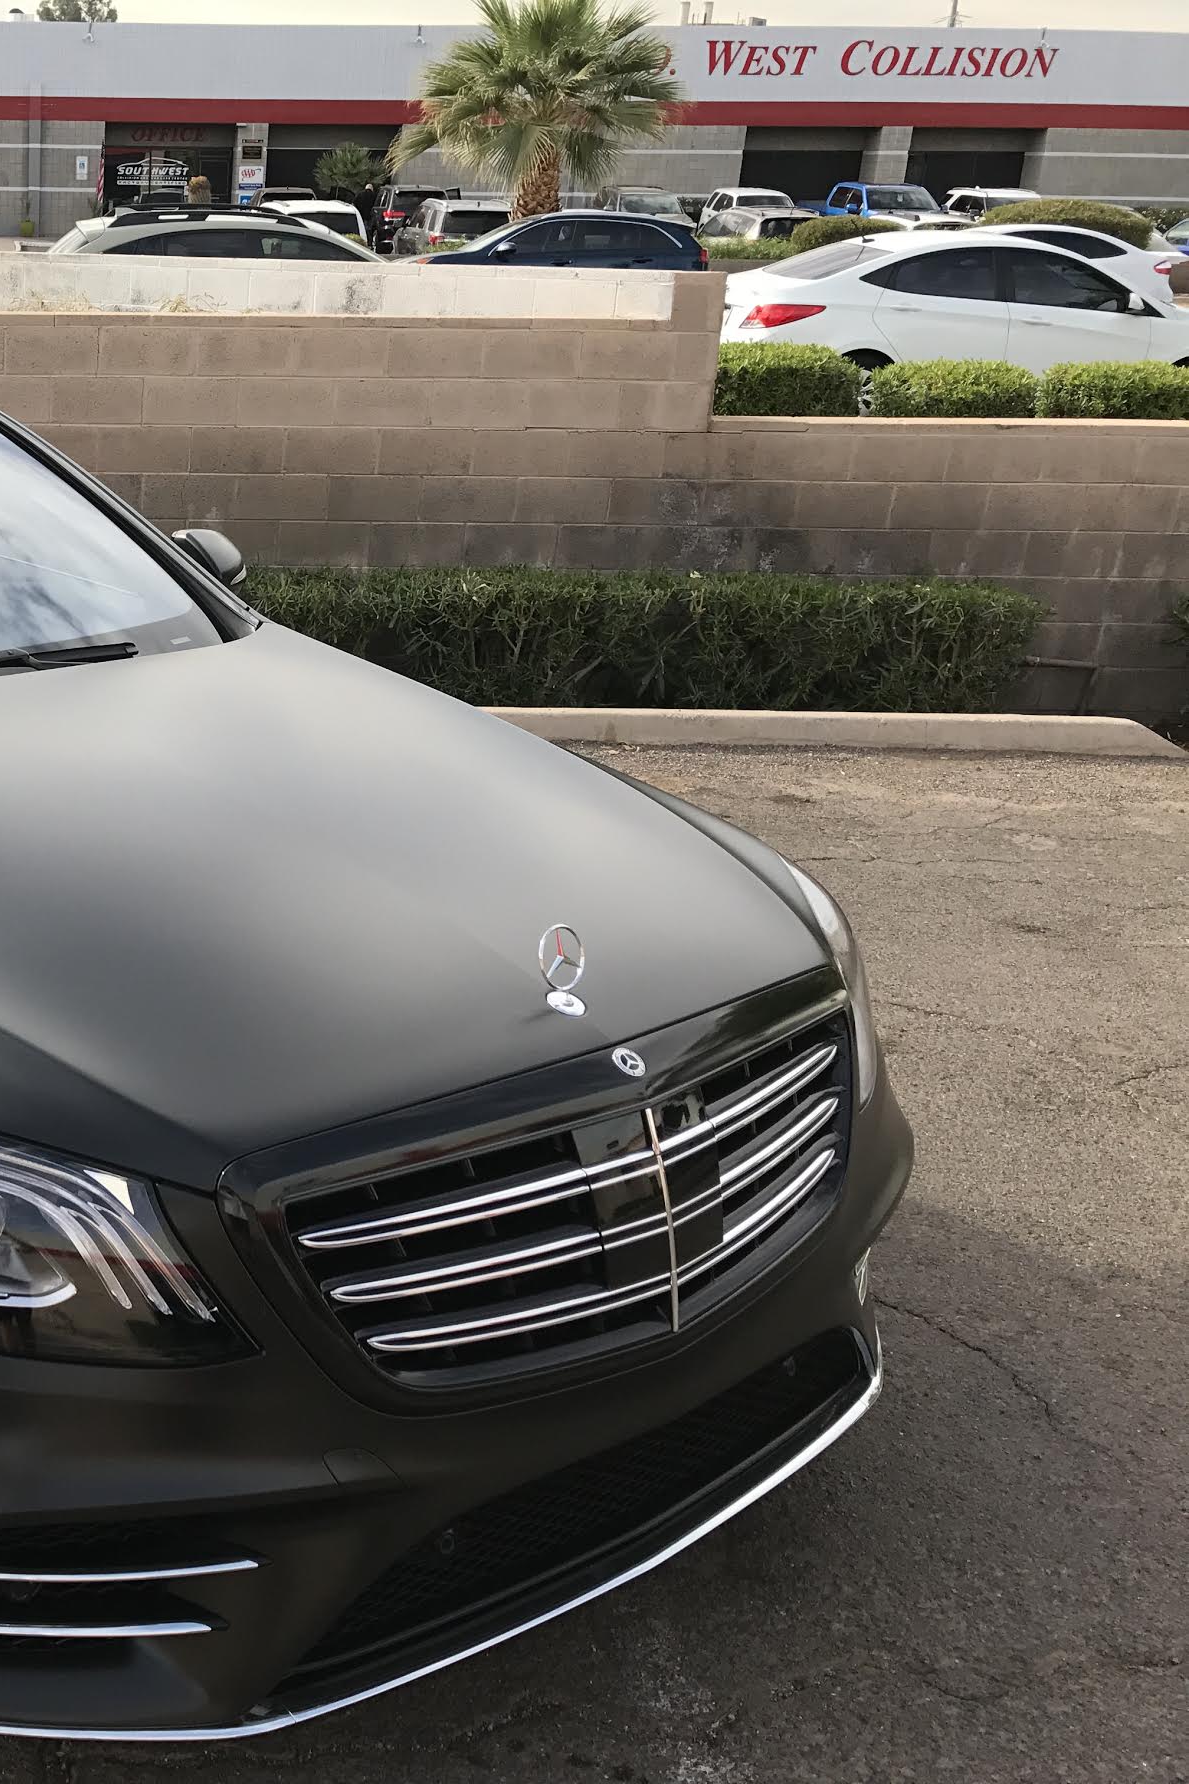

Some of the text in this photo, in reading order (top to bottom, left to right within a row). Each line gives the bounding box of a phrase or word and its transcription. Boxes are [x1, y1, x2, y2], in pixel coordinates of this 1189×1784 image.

[705, 40, 817, 77] WEST
[839, 39, 1060, 78] COLLISION
[130, 126, 209, 142] OFFICE
[117, 166, 189, 175] SOUTHWEST
